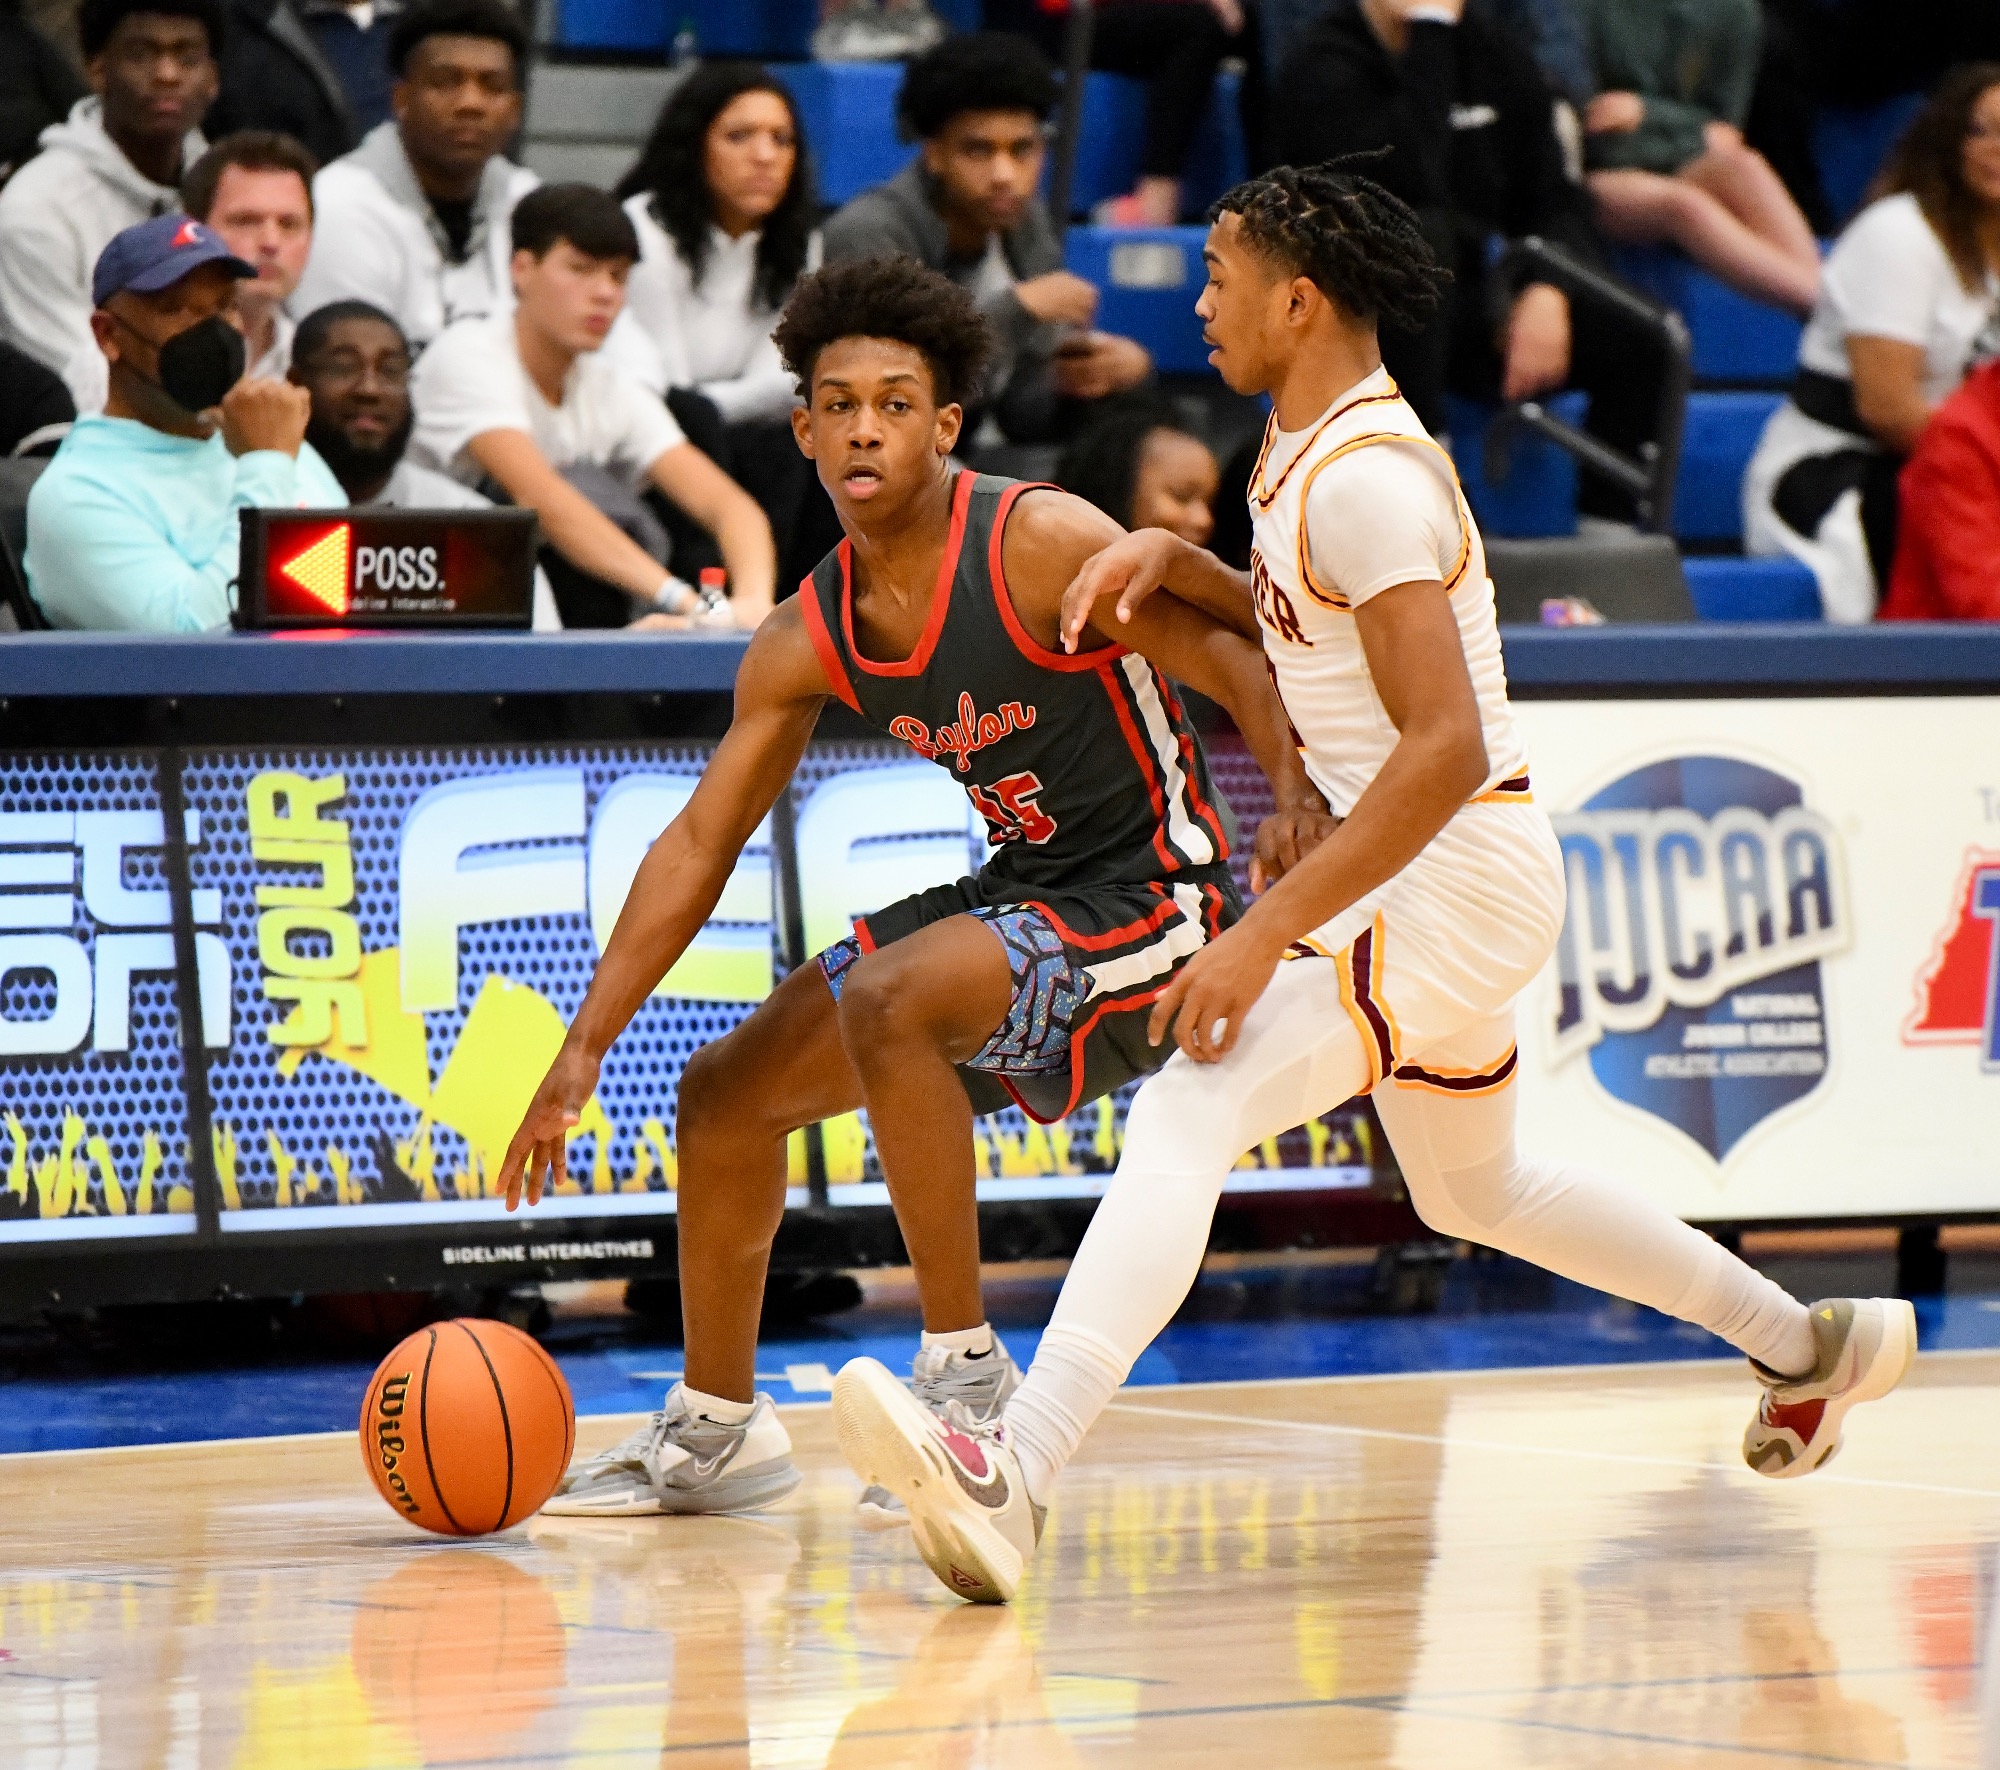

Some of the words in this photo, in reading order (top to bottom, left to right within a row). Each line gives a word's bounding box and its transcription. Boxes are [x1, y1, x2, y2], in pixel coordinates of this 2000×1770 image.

[354, 546, 446, 591] POSS.
[889, 691, 1037, 772] Baylor
[966, 770, 1058, 845] 15
[247, 770, 368, 1049] YOUR
[1556, 827, 1833, 1032] NJCAA
[442, 1245, 526, 1264] SIDELINE
[378, 1371, 422, 1514] Wilson
